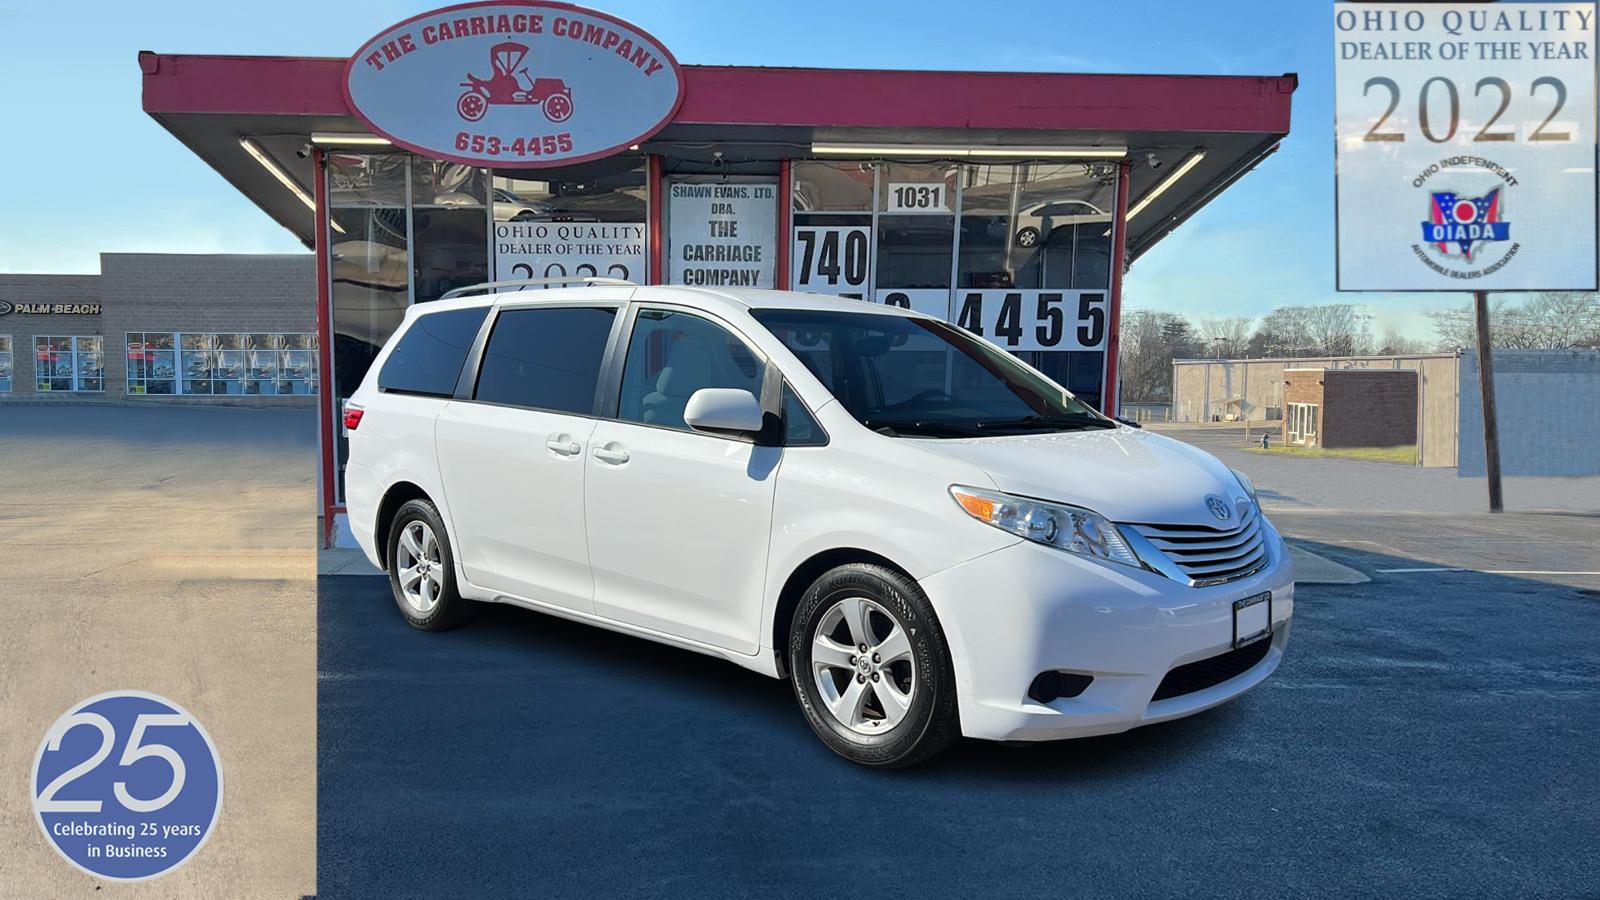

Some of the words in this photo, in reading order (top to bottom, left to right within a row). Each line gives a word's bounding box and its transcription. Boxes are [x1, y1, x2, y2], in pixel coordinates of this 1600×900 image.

[1337, 10, 1424, 31] OHIO
[1442, 10, 1592, 36] QUALITY
[365, 34, 416, 71] THE
[422, 14, 543, 46] CARRIAGE
[552, 17, 663, 77] COMPANY
[1340, 42, 1433, 60] DEALER
[1439, 42, 1469, 60] OF
[1475, 42, 1522, 60] THE
[1528, 42, 1588, 60] YEAR
[1363, 76, 1571, 143] 2022
[455, 132, 573, 156] 653-4455
[1413, 164, 1439, 188] OHIO
[1440, 155, 1519, 187] INDEPENDENT
[672, 185, 711, 198] SHAWN
[754, 187, 774, 199] LTD.
[894, 187, 940, 207] 1031
[711, 203, 736, 215] DBA.
[497, 226, 548, 238] OHIO
[558, 226, 644, 240] QUALITY
[708, 221, 738, 237] THE
[1433, 224, 1494, 240] OIADA
[499, 244, 551, 254] DEALER
[555, 244, 573, 254] OF
[576, 244, 602, 255] THE
[606, 244, 641, 255] YEAR
[683, 244, 762, 262] CARRIAGE
[797, 230, 868, 286] 740
[683, 268, 760, 286] COMPANY
[1450, 270, 1482, 279] DEALERS
[15, 303, 51, 314] PALM
[55, 304, 101, 314] BEACH
